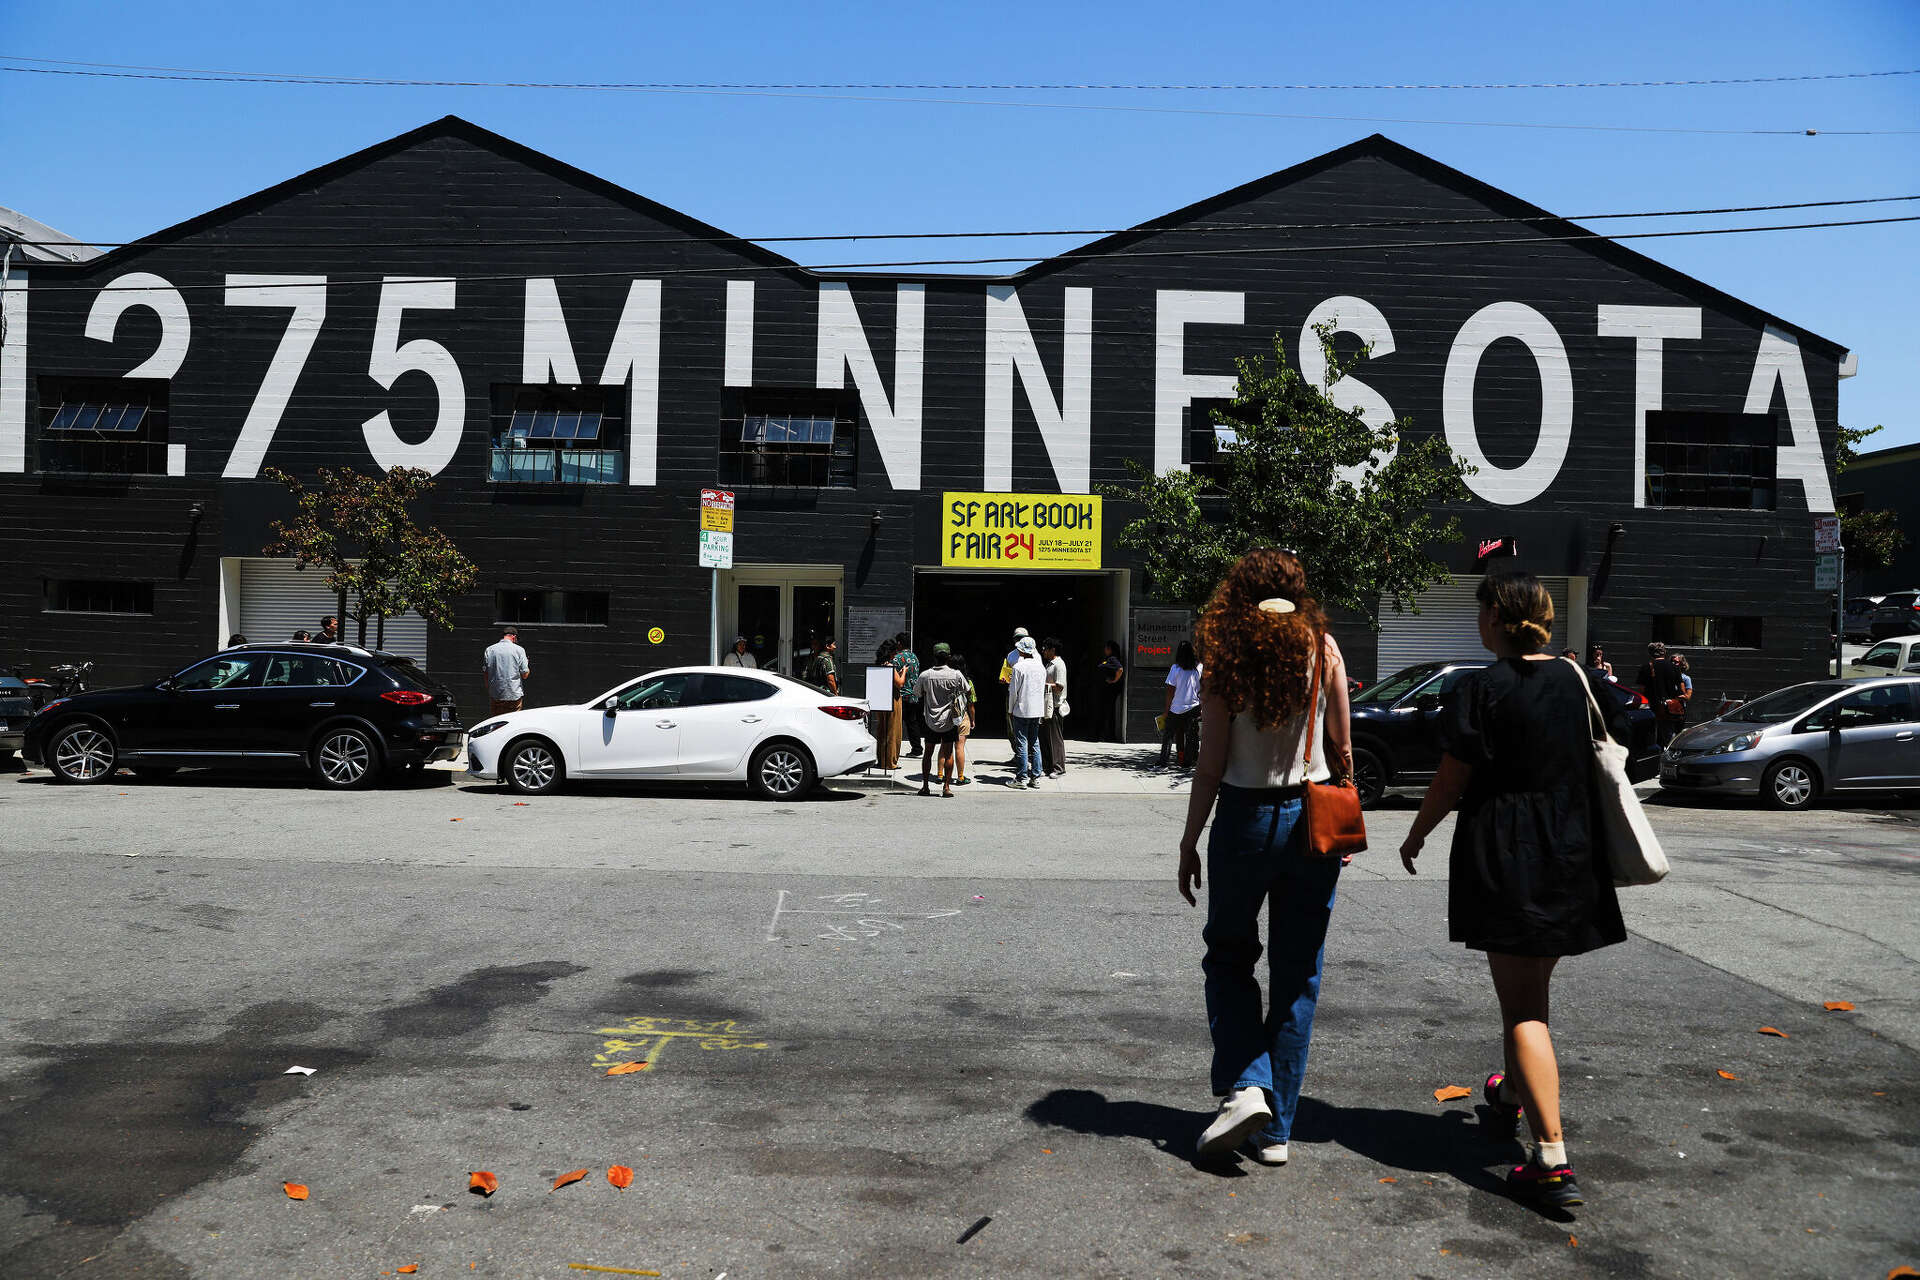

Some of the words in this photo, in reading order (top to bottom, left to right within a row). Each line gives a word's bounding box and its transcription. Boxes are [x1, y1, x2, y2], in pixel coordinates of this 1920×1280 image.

[522, 278, 1836, 513] MINNESOTA
[951, 500, 981, 528] SF
[1032, 502, 1093, 530] BOOK
[703, 543, 729, 553] PARKING
[950, 531, 1001, 560] FAIR
[1004, 533, 1034, 561] 24
[1137, 623, 1187, 632] Minnesota
[1137, 634, 1169, 643] Street
[1137, 644, 1171, 656] Project
